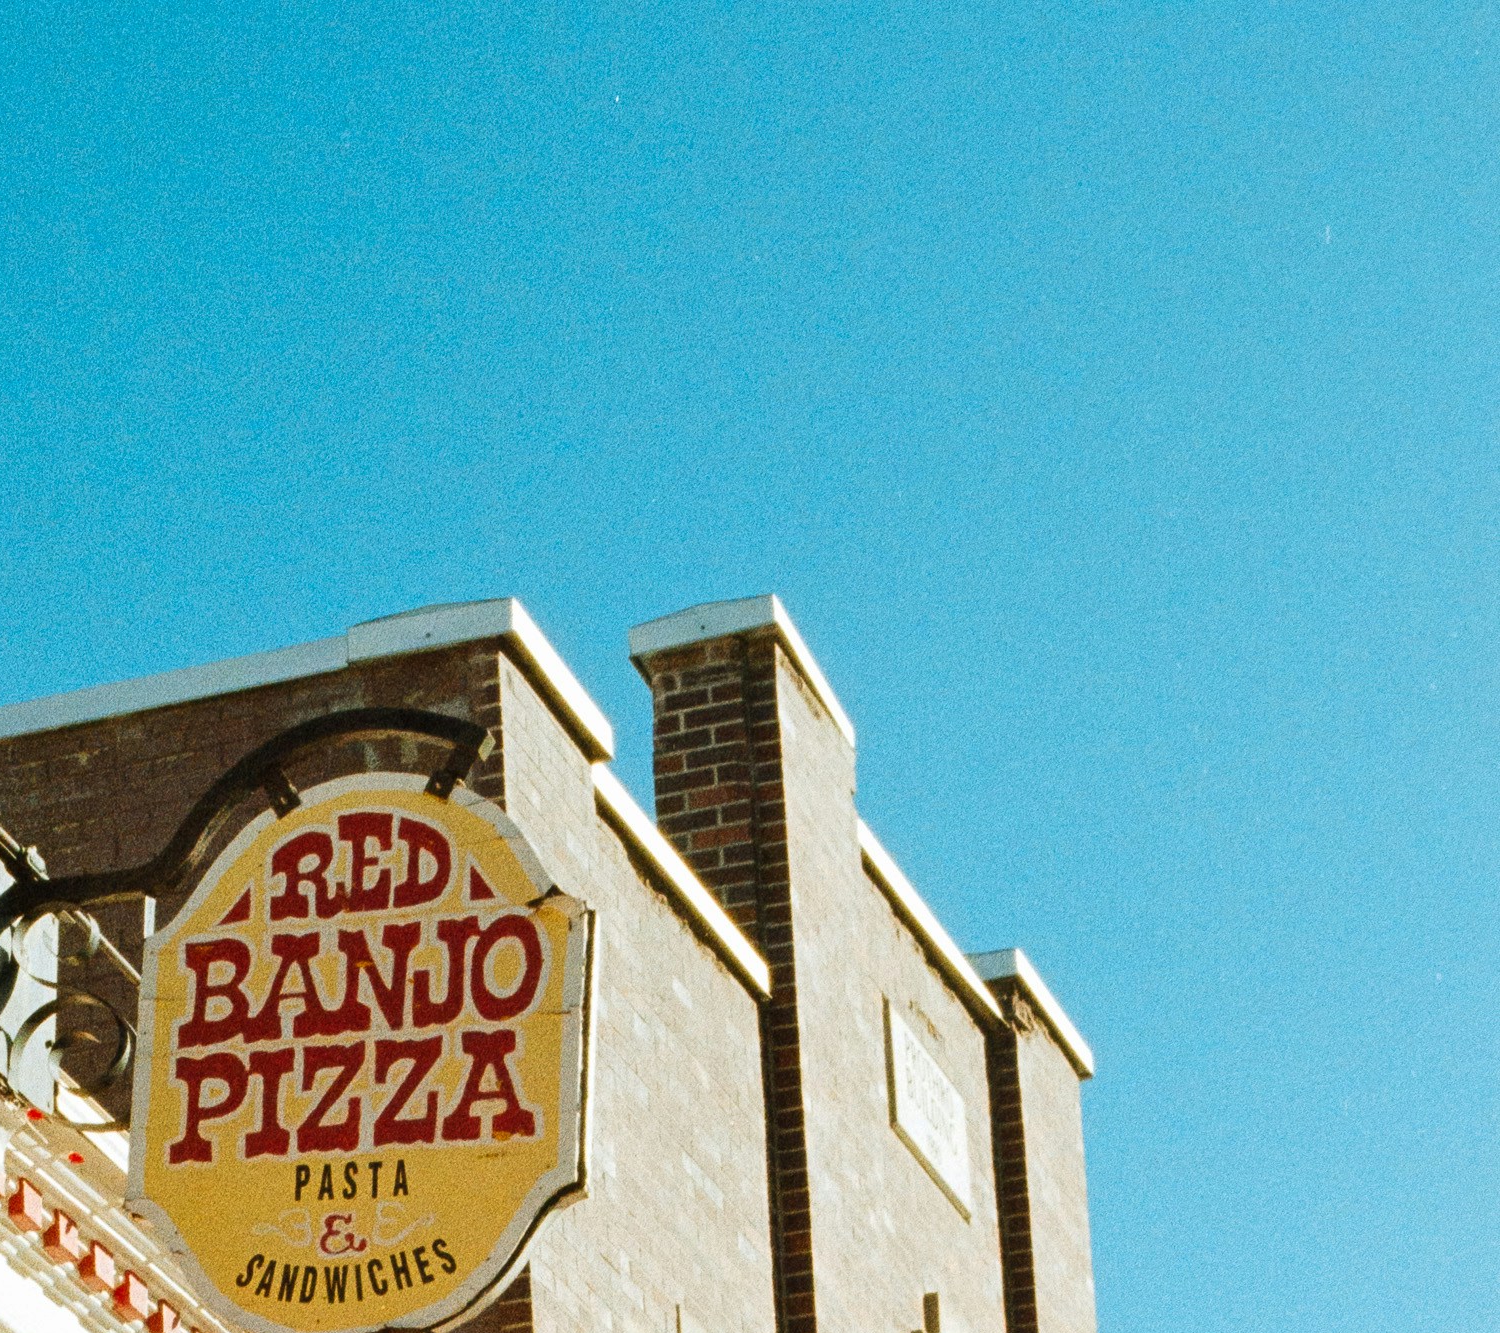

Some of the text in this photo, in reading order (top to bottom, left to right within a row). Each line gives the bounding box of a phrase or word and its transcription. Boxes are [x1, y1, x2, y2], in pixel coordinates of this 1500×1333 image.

[269, 811, 452, 921] RED
[177, 913, 543, 1048] BANJO
[168, 1029, 536, 1165] PIZZA
[294, 1159, 410, 1201] PASTA
[235, 1238, 458, 1304] SANDWICHES
[320, 1214, 367, 1254] &
